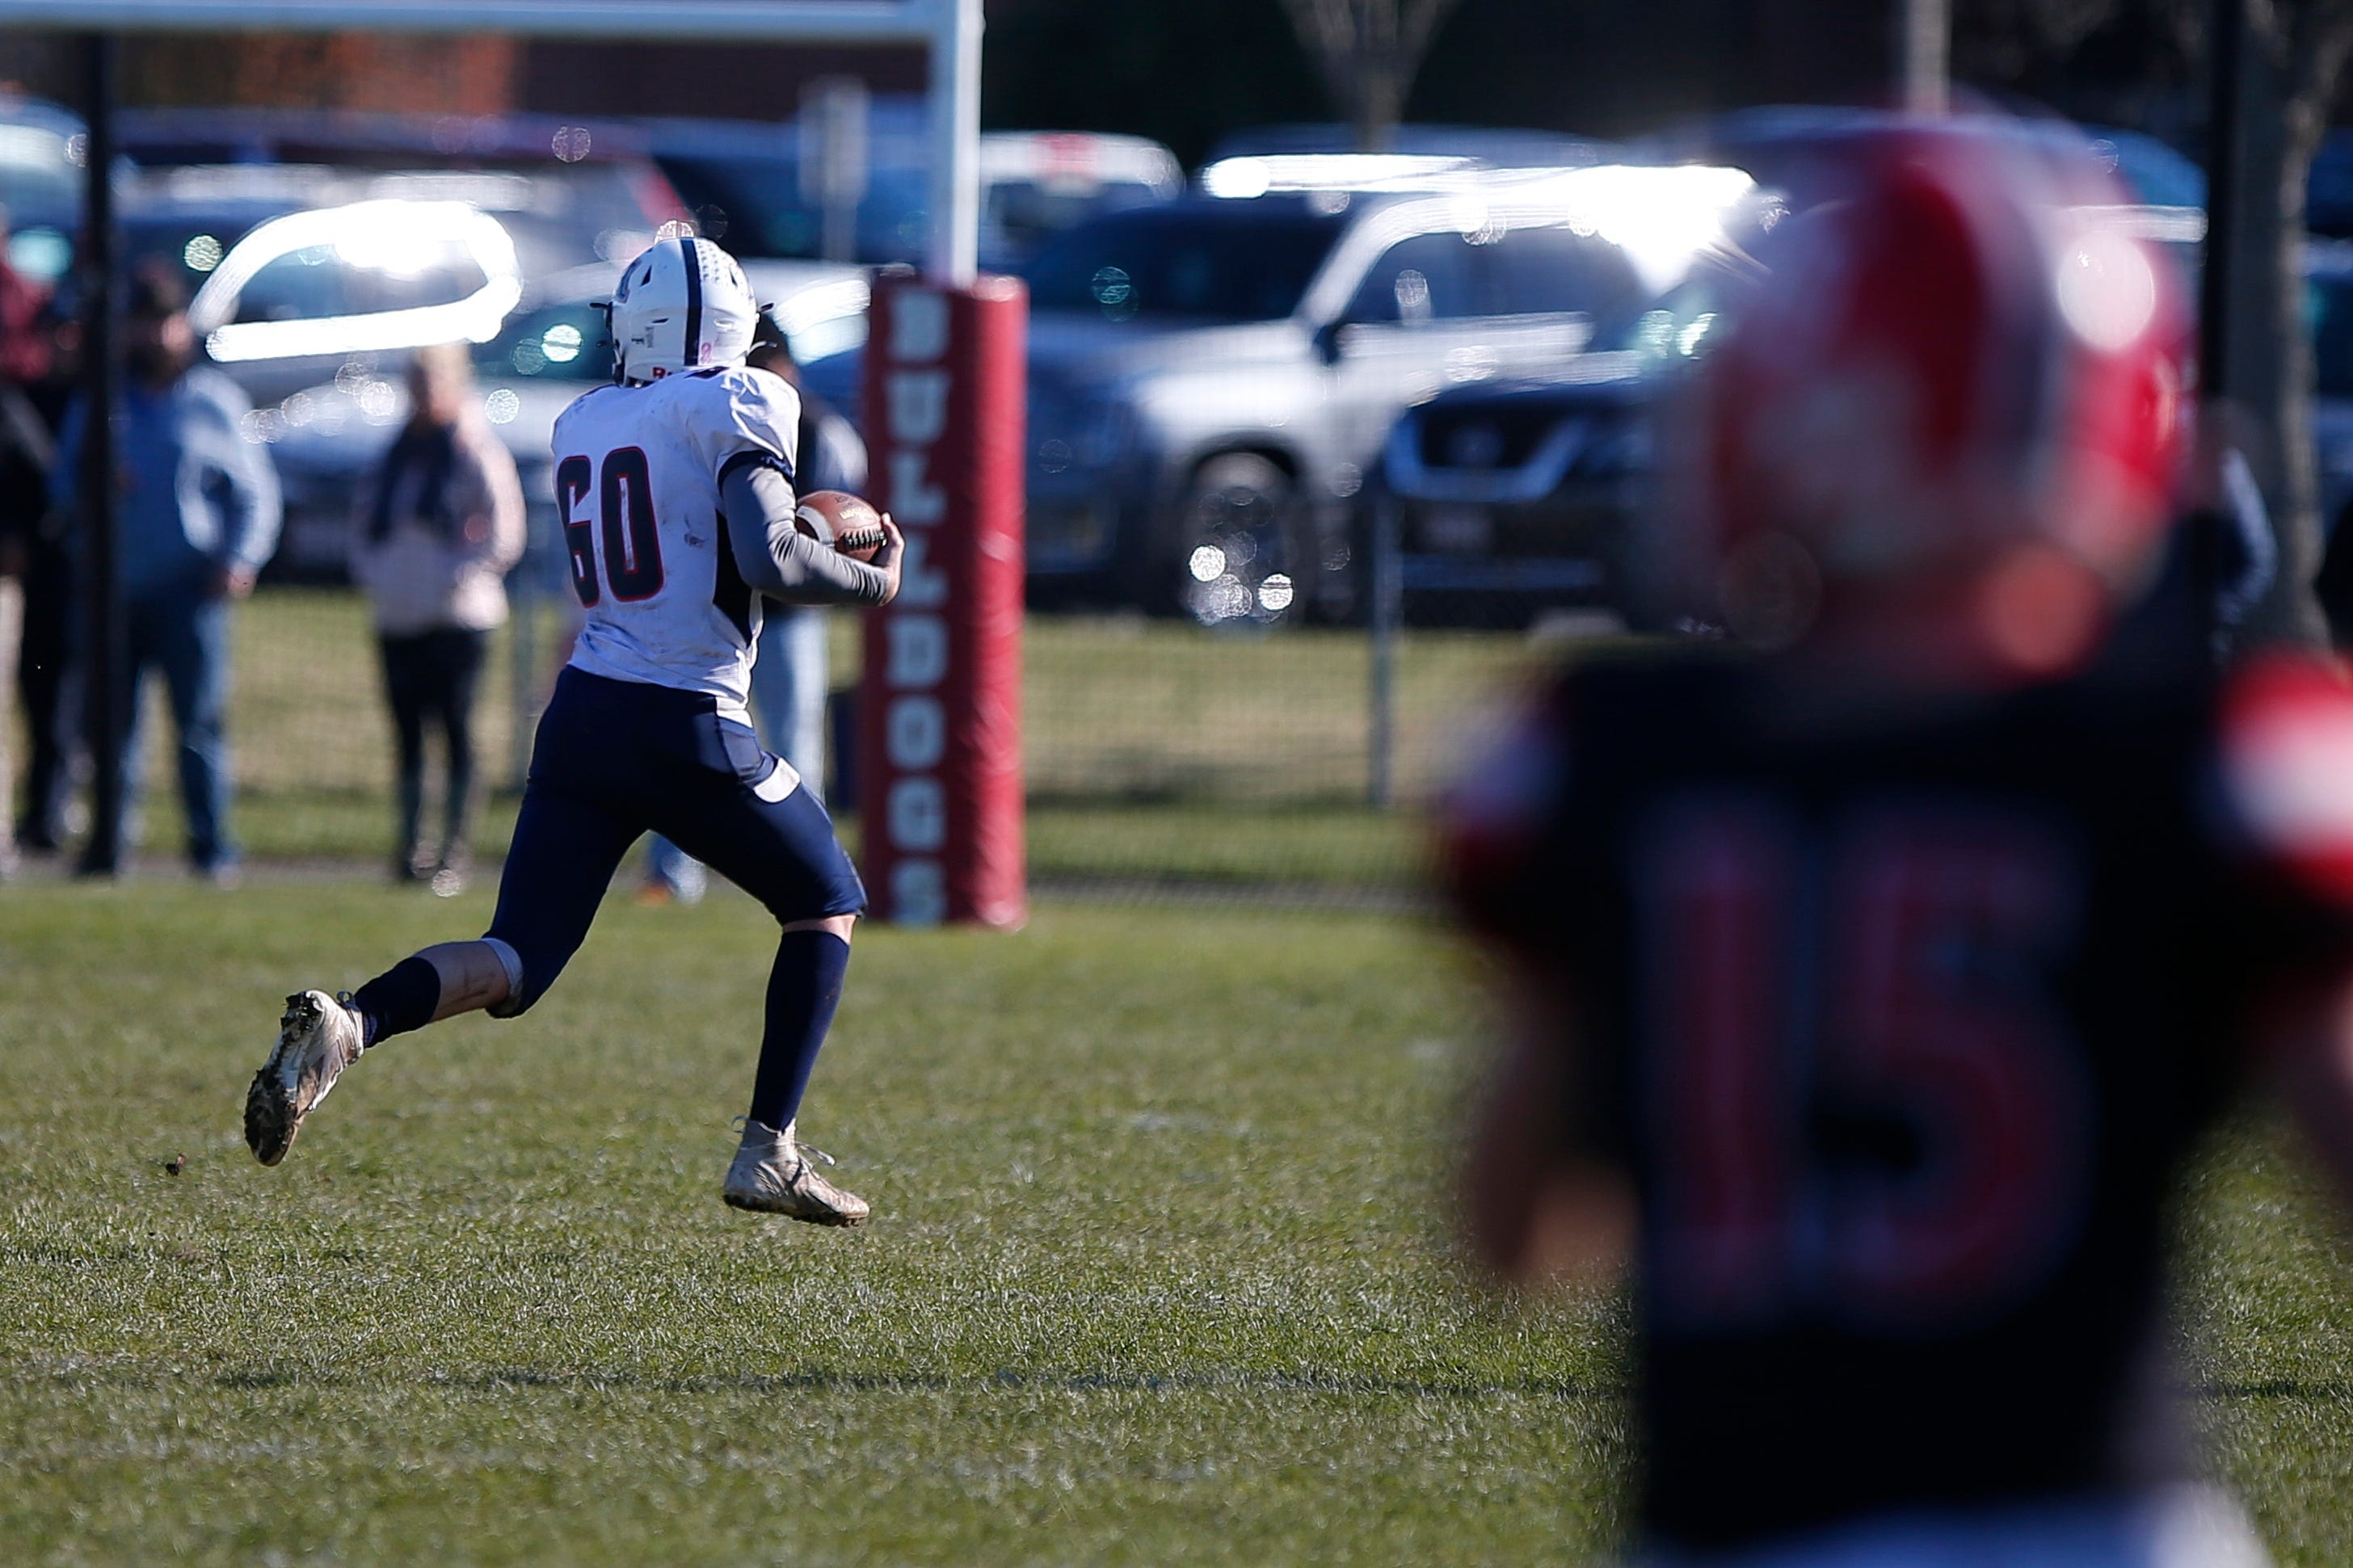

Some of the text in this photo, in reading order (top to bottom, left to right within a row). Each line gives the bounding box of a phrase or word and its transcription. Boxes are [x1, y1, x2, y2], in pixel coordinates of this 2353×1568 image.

[557, 446, 664, 608] 60
[886, 288, 949, 927] BULLDOGS
[1628, 788, 2093, 1333] 15
